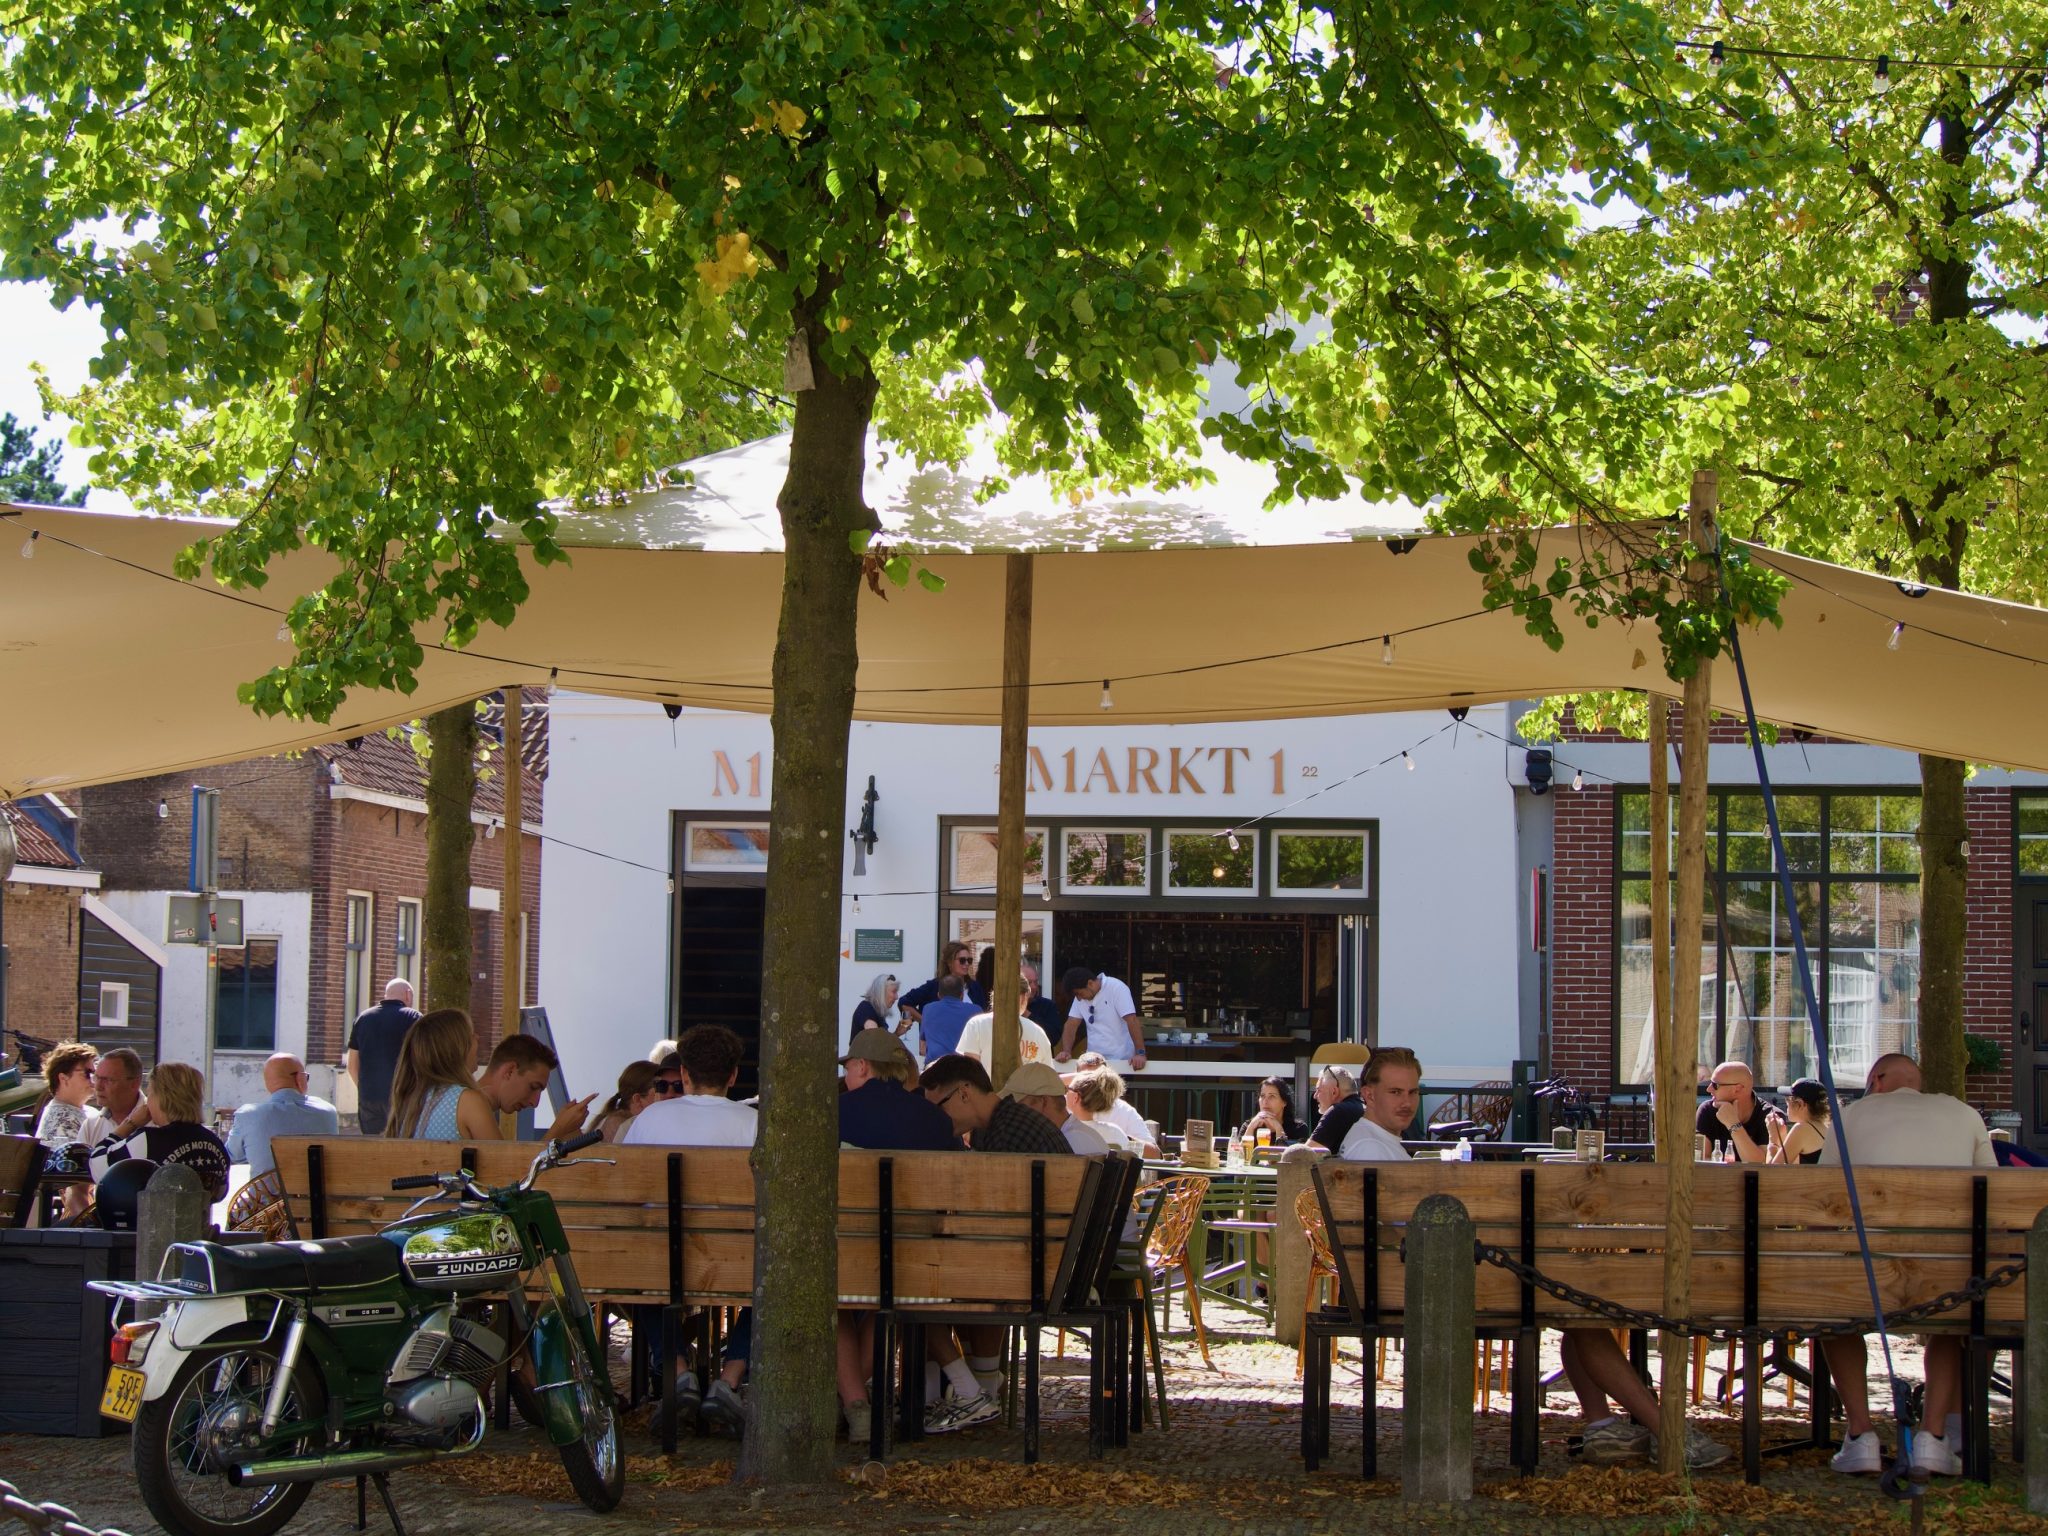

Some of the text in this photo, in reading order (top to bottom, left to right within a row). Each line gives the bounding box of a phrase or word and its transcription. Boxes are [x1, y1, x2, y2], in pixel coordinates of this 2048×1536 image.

[1269, 747, 1285, 795] 1
[1301, 765, 1318, 778] 22
[167, 1143, 191, 1163] DEUS
[437, 1257, 518, 1275] ZÜNDAPP
